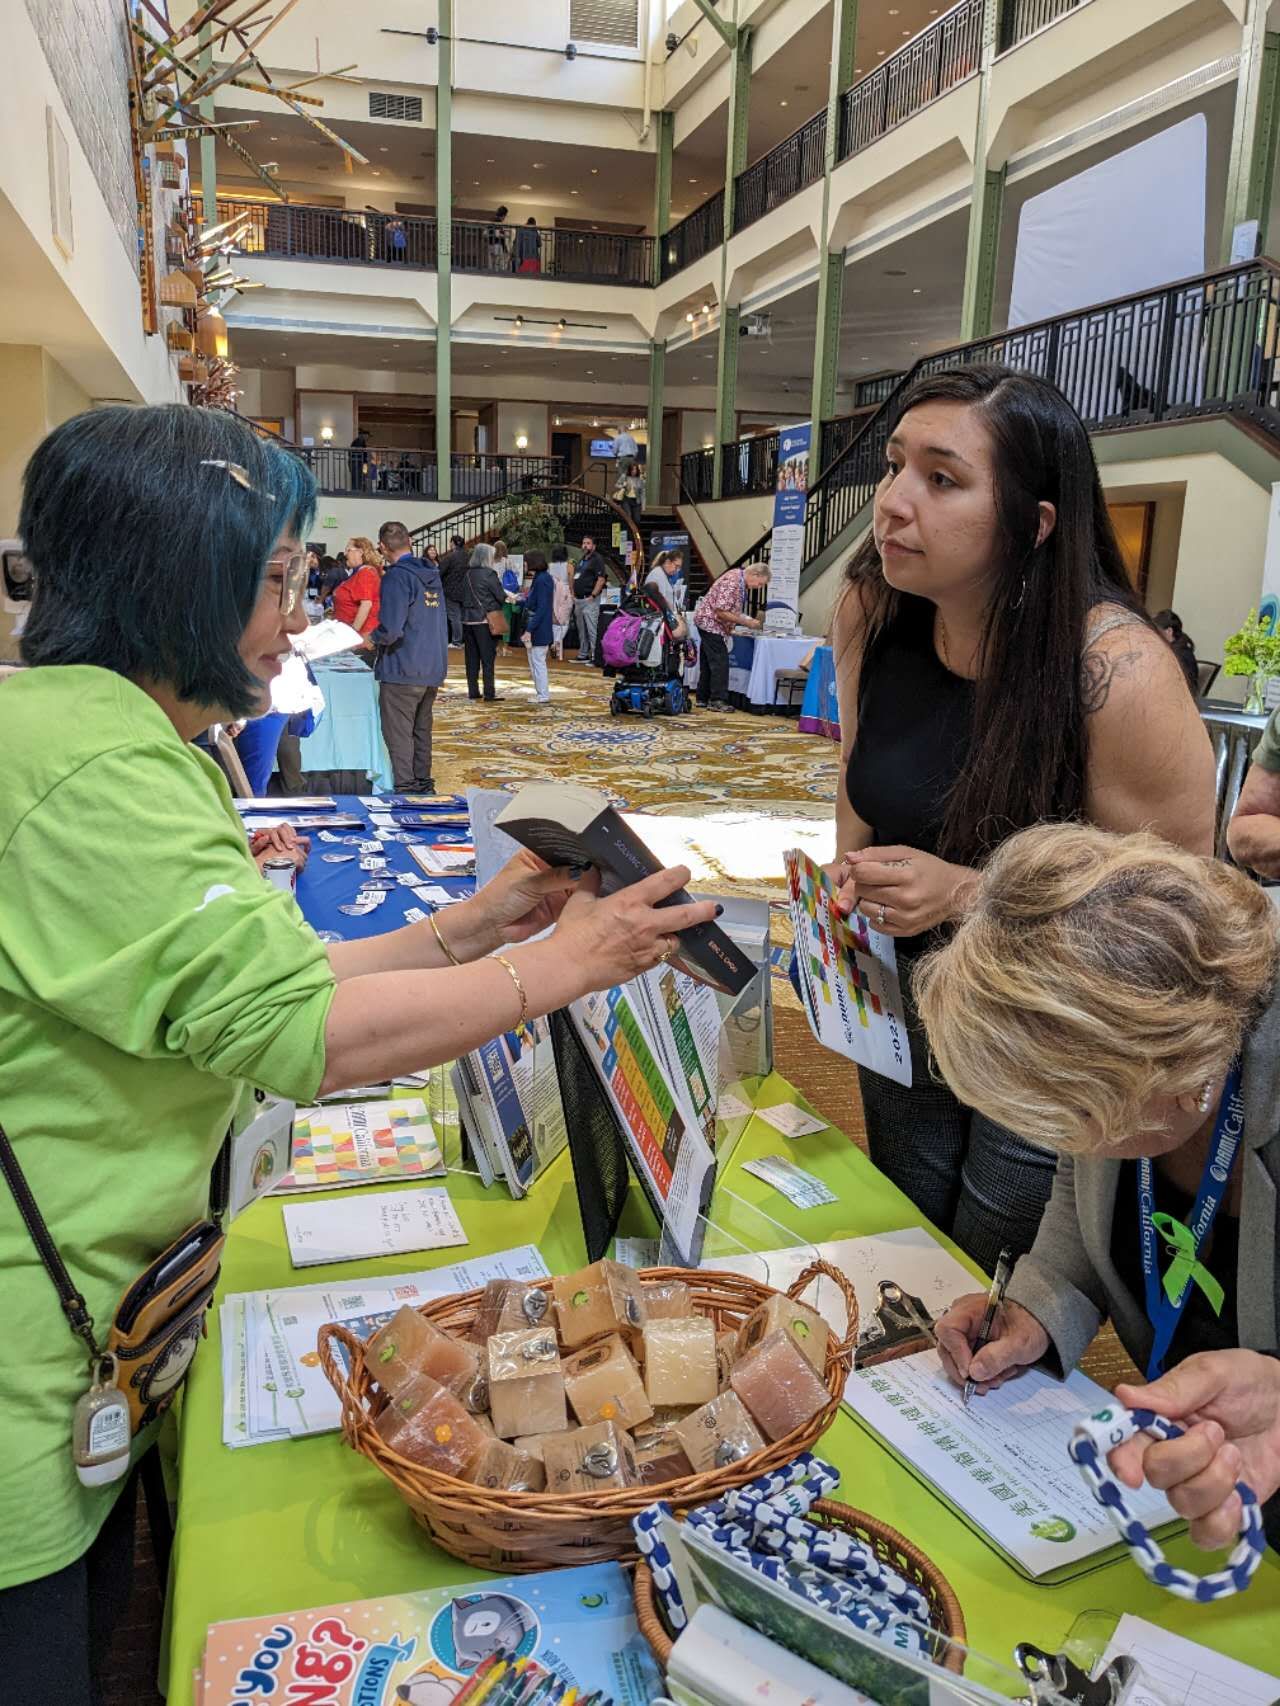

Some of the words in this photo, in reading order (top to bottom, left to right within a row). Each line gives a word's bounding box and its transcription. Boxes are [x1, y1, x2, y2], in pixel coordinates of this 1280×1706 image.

[887, 1012, 903, 1065] 2023
[1141, 1192, 1155, 1274] California
[1016, 1484, 1052, 1512] Mental
